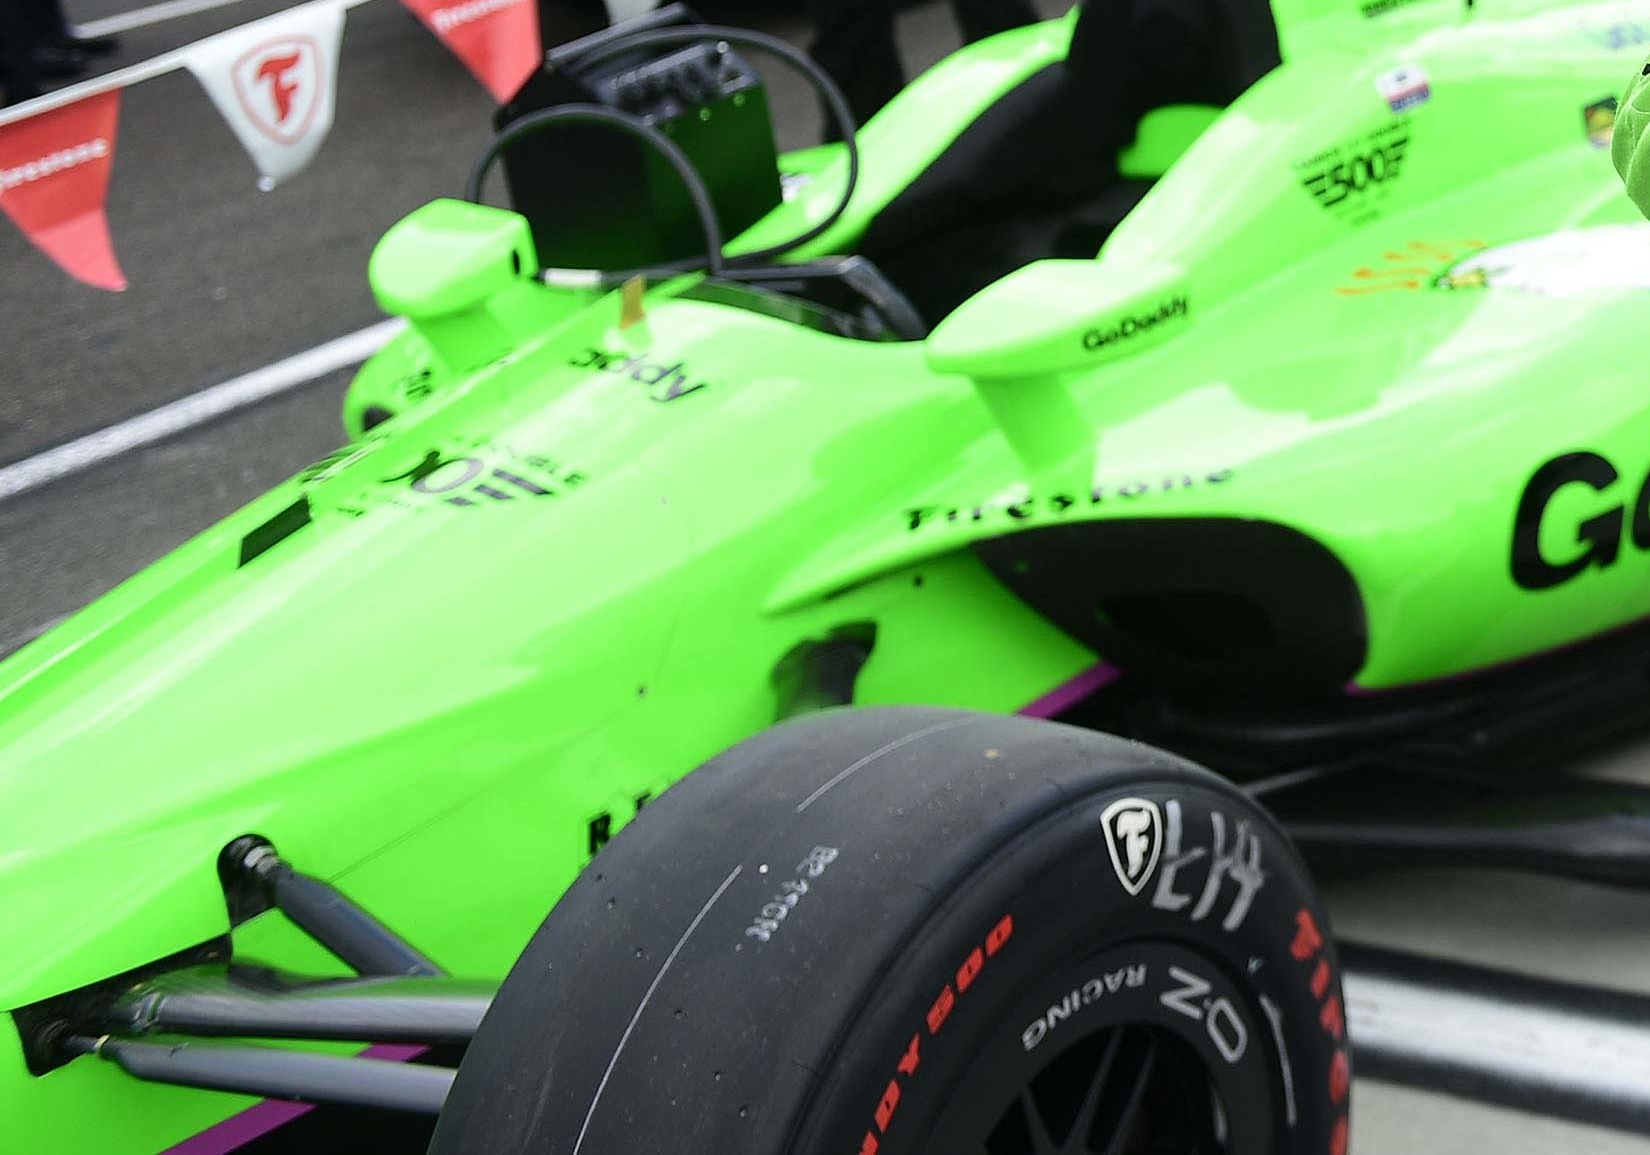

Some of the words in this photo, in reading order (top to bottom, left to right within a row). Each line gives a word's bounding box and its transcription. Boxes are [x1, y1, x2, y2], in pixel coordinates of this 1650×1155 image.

[1082, 296, 1190, 351] GoDaddy
[926, 913, 1014, 1035] 500
[1021, 962, 1147, 1051] RACING
